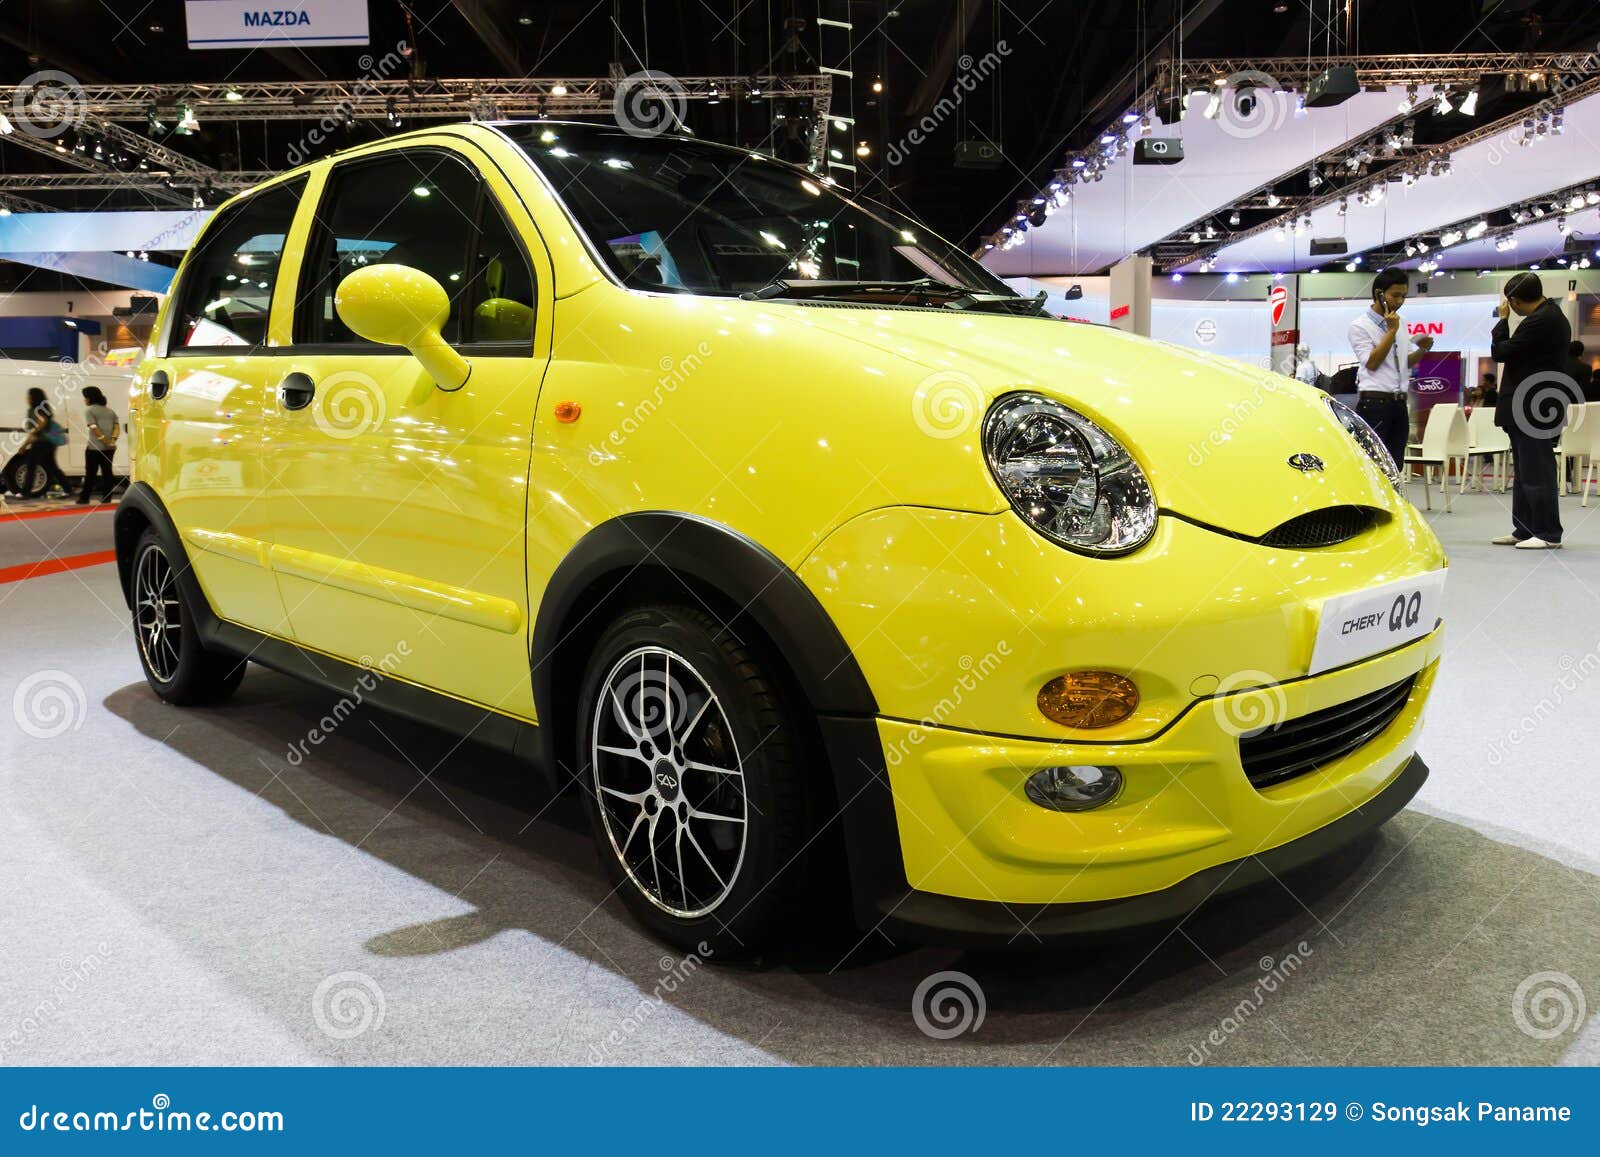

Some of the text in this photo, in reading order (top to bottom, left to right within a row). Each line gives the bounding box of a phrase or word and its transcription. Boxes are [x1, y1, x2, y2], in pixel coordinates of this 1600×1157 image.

[244, 11, 310, 26] MAZDA
[1417, 283, 1428, 293] 16
[1408, 322, 1443, 335] AN
[1341, 591, 1422, 635] CHERY QQ
